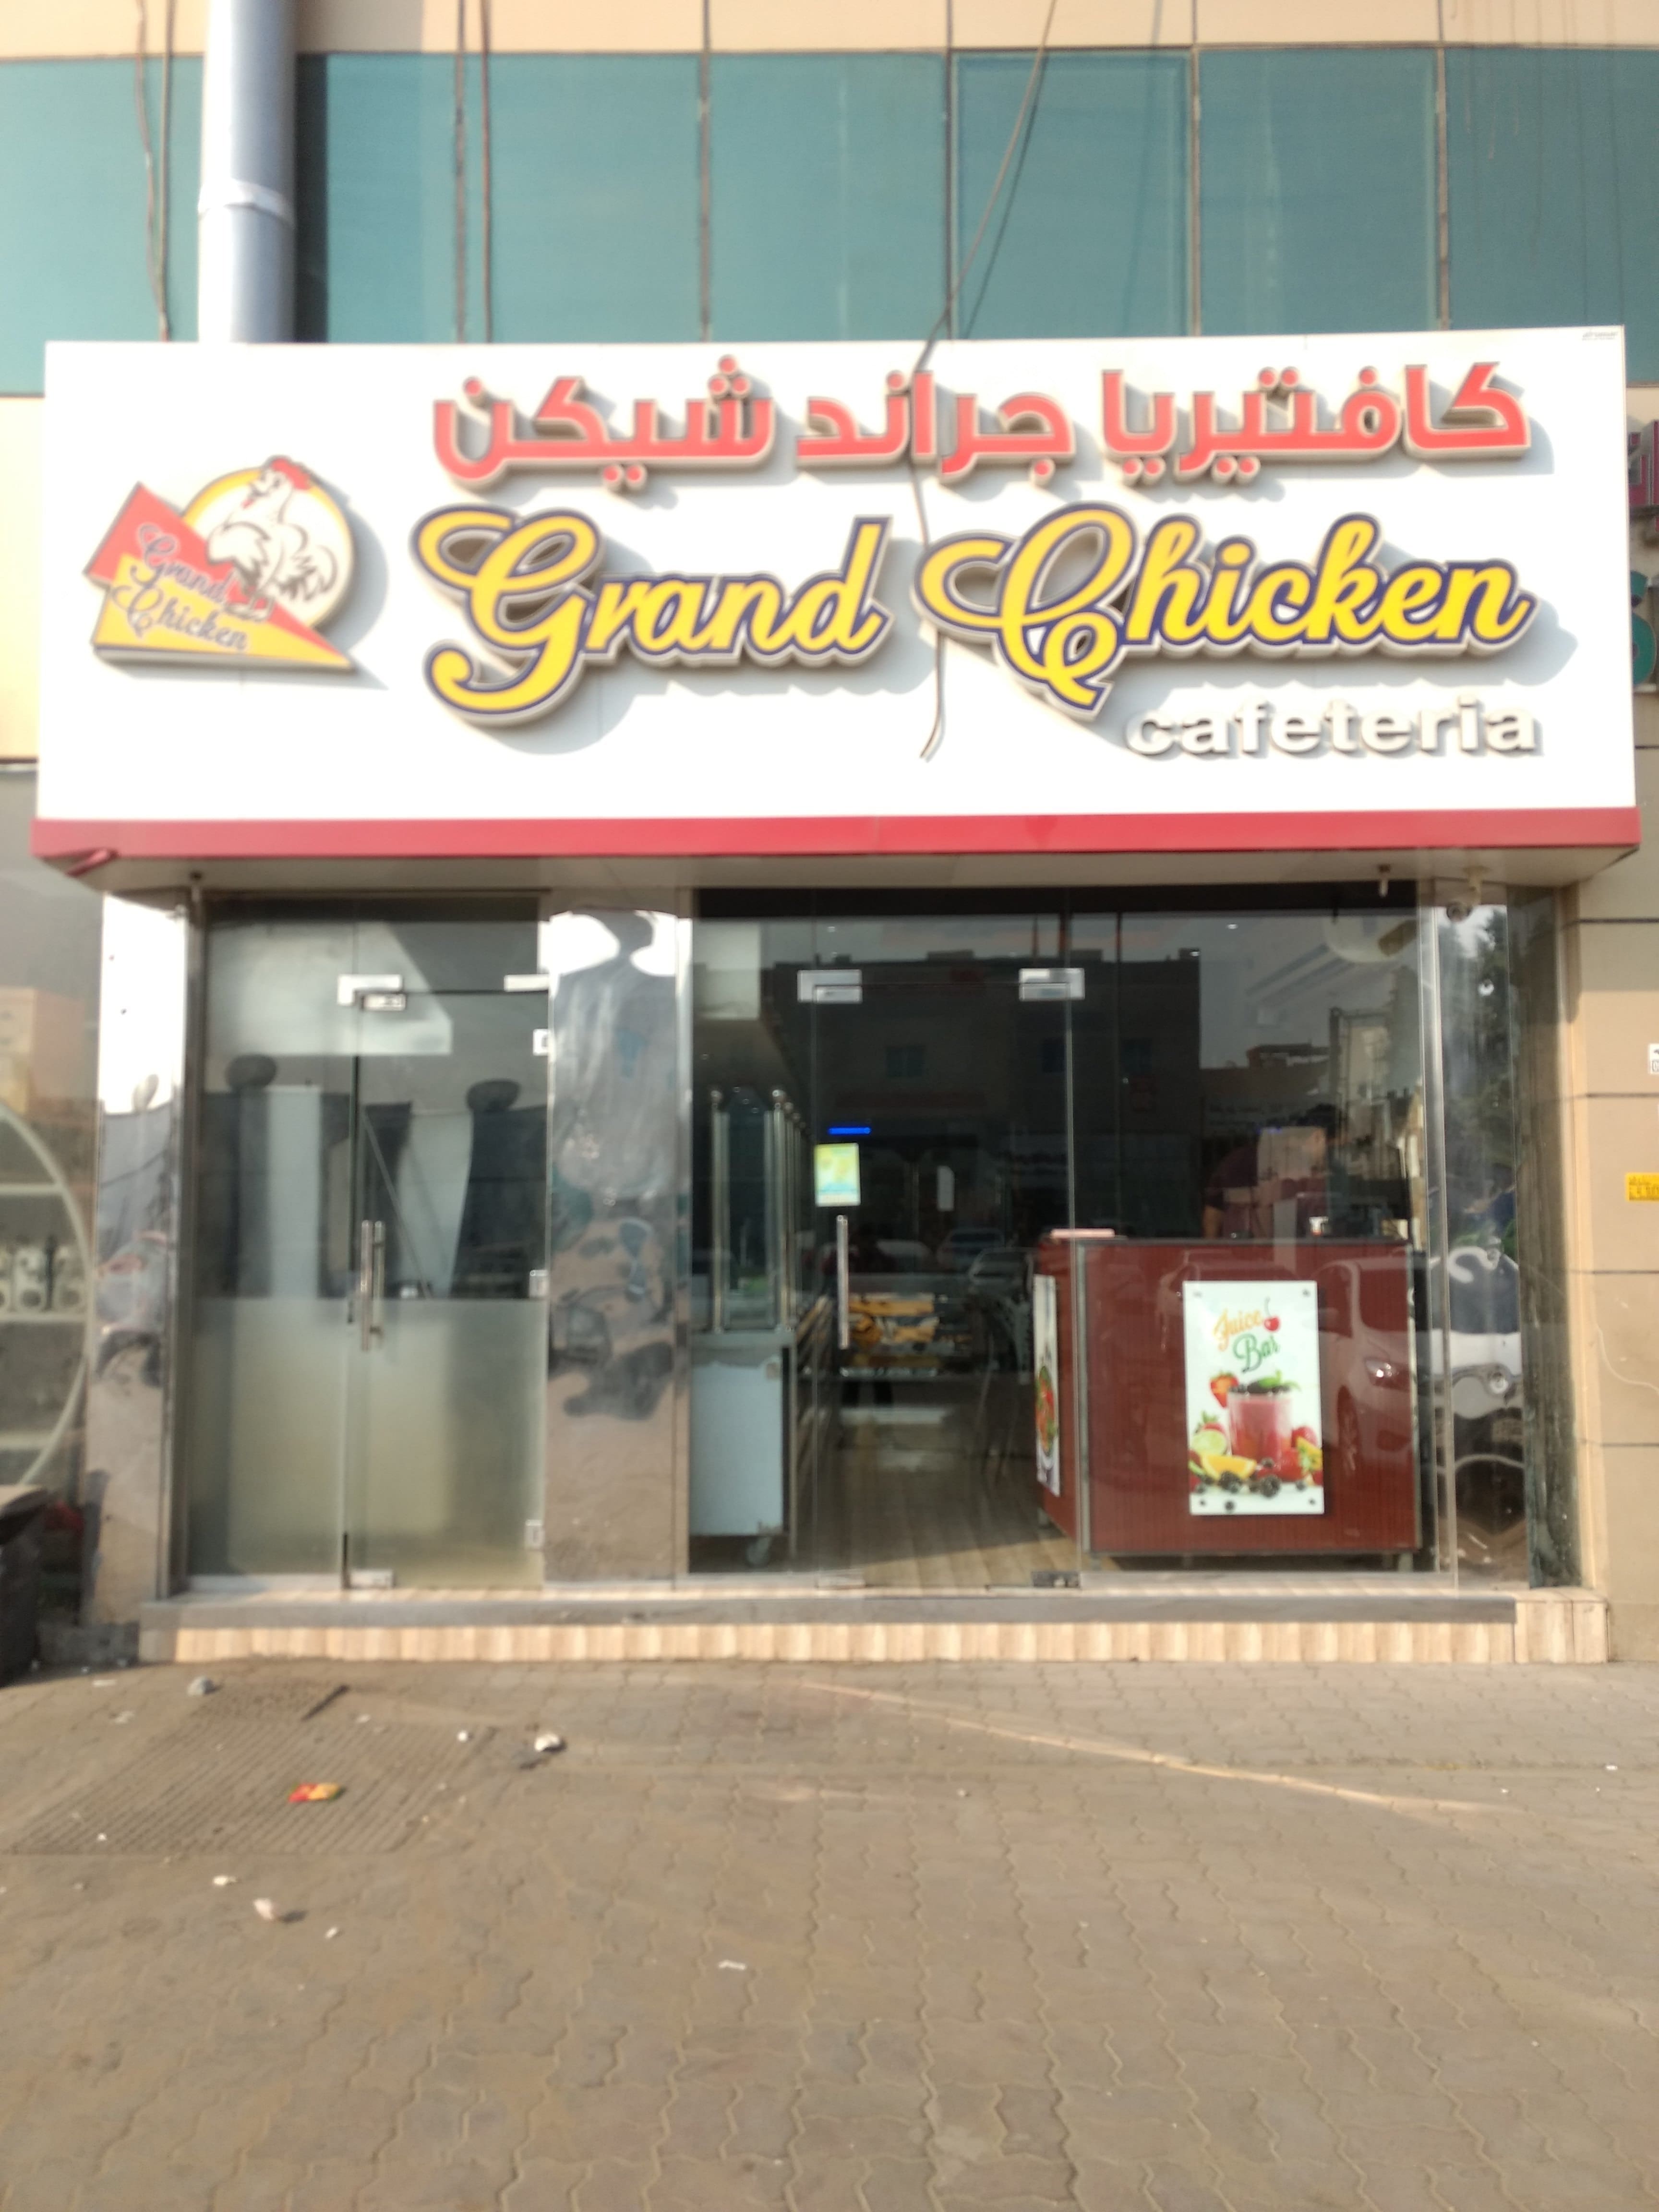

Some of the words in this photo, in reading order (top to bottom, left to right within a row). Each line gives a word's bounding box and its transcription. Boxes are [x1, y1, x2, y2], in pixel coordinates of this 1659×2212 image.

[433, 357, 774, 491] شيكن
[797, 371, 1074, 483] جراند
[1101, 362, 1529, 484] كافتيريا
[130, 524, 236, 604] Grand
[112, 585, 247, 650] Chicken
[410, 504, 894, 726] Grand
[913, 501, 1537, 717] Chicken
[1127, 696, 1538, 755] cafeteria
[1213, 1309, 1262, 1352] Juice
[1233, 1333, 1280, 1373] Bar
